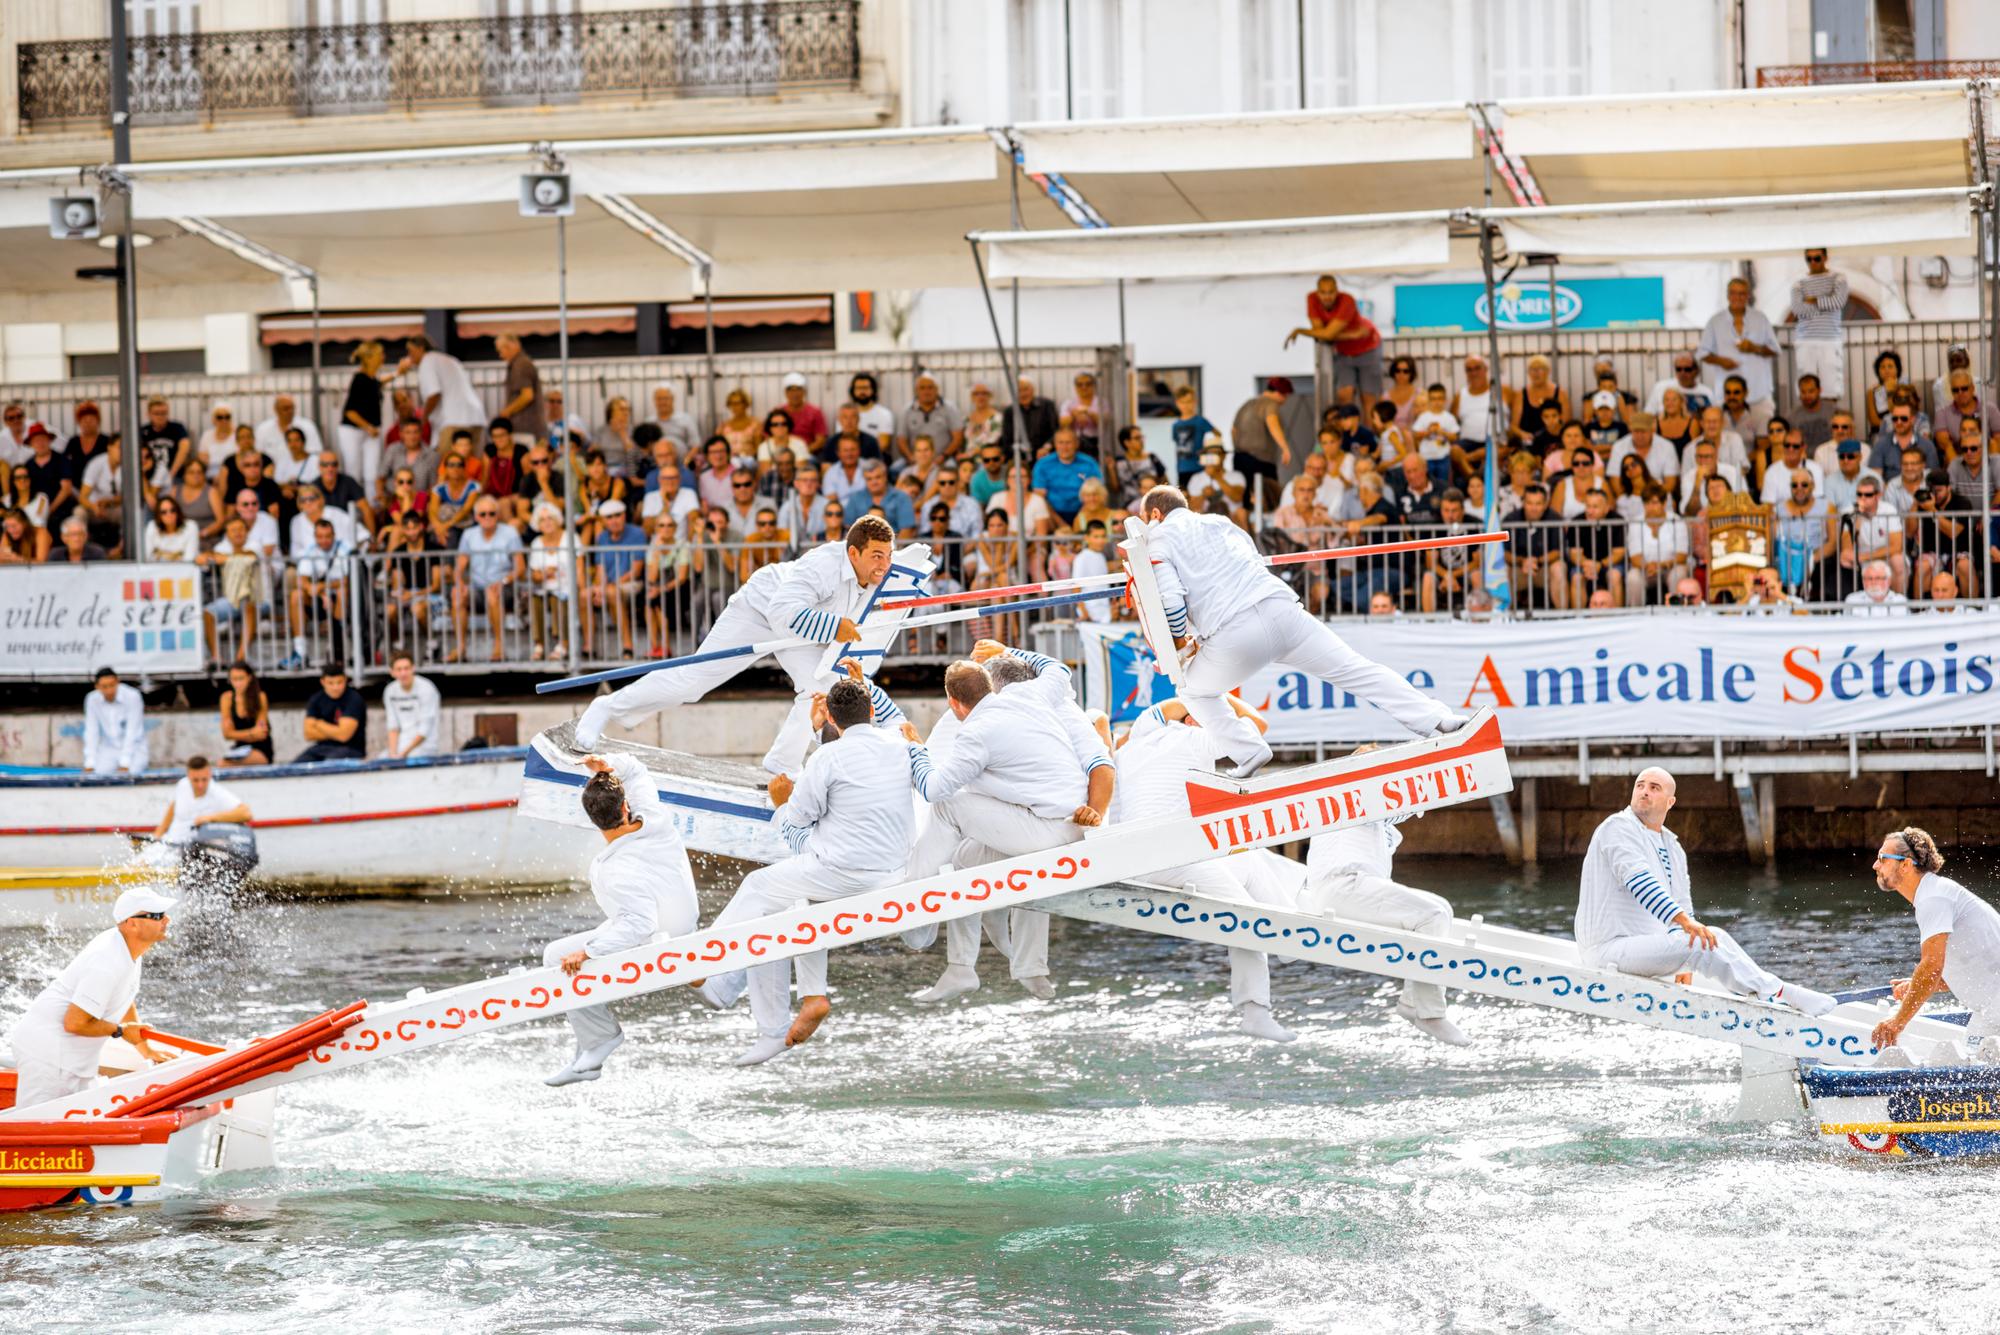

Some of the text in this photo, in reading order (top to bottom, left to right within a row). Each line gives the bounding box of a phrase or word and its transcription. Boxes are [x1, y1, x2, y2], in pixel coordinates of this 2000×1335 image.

[6, 594, 68, 628] ville
[78, 593, 110, 627] de
[7, 634, 104, 659] www.sete.fr
[1462, 647, 1756, 708] Amicale
[1783, 642, 1993, 704] Sétois
[1201, 763, 1478, 850] VILLE DE SETE
[1916, 1094, 1992, 1121] Joseph
[0, 1149, 85, 1170] Licciardi
